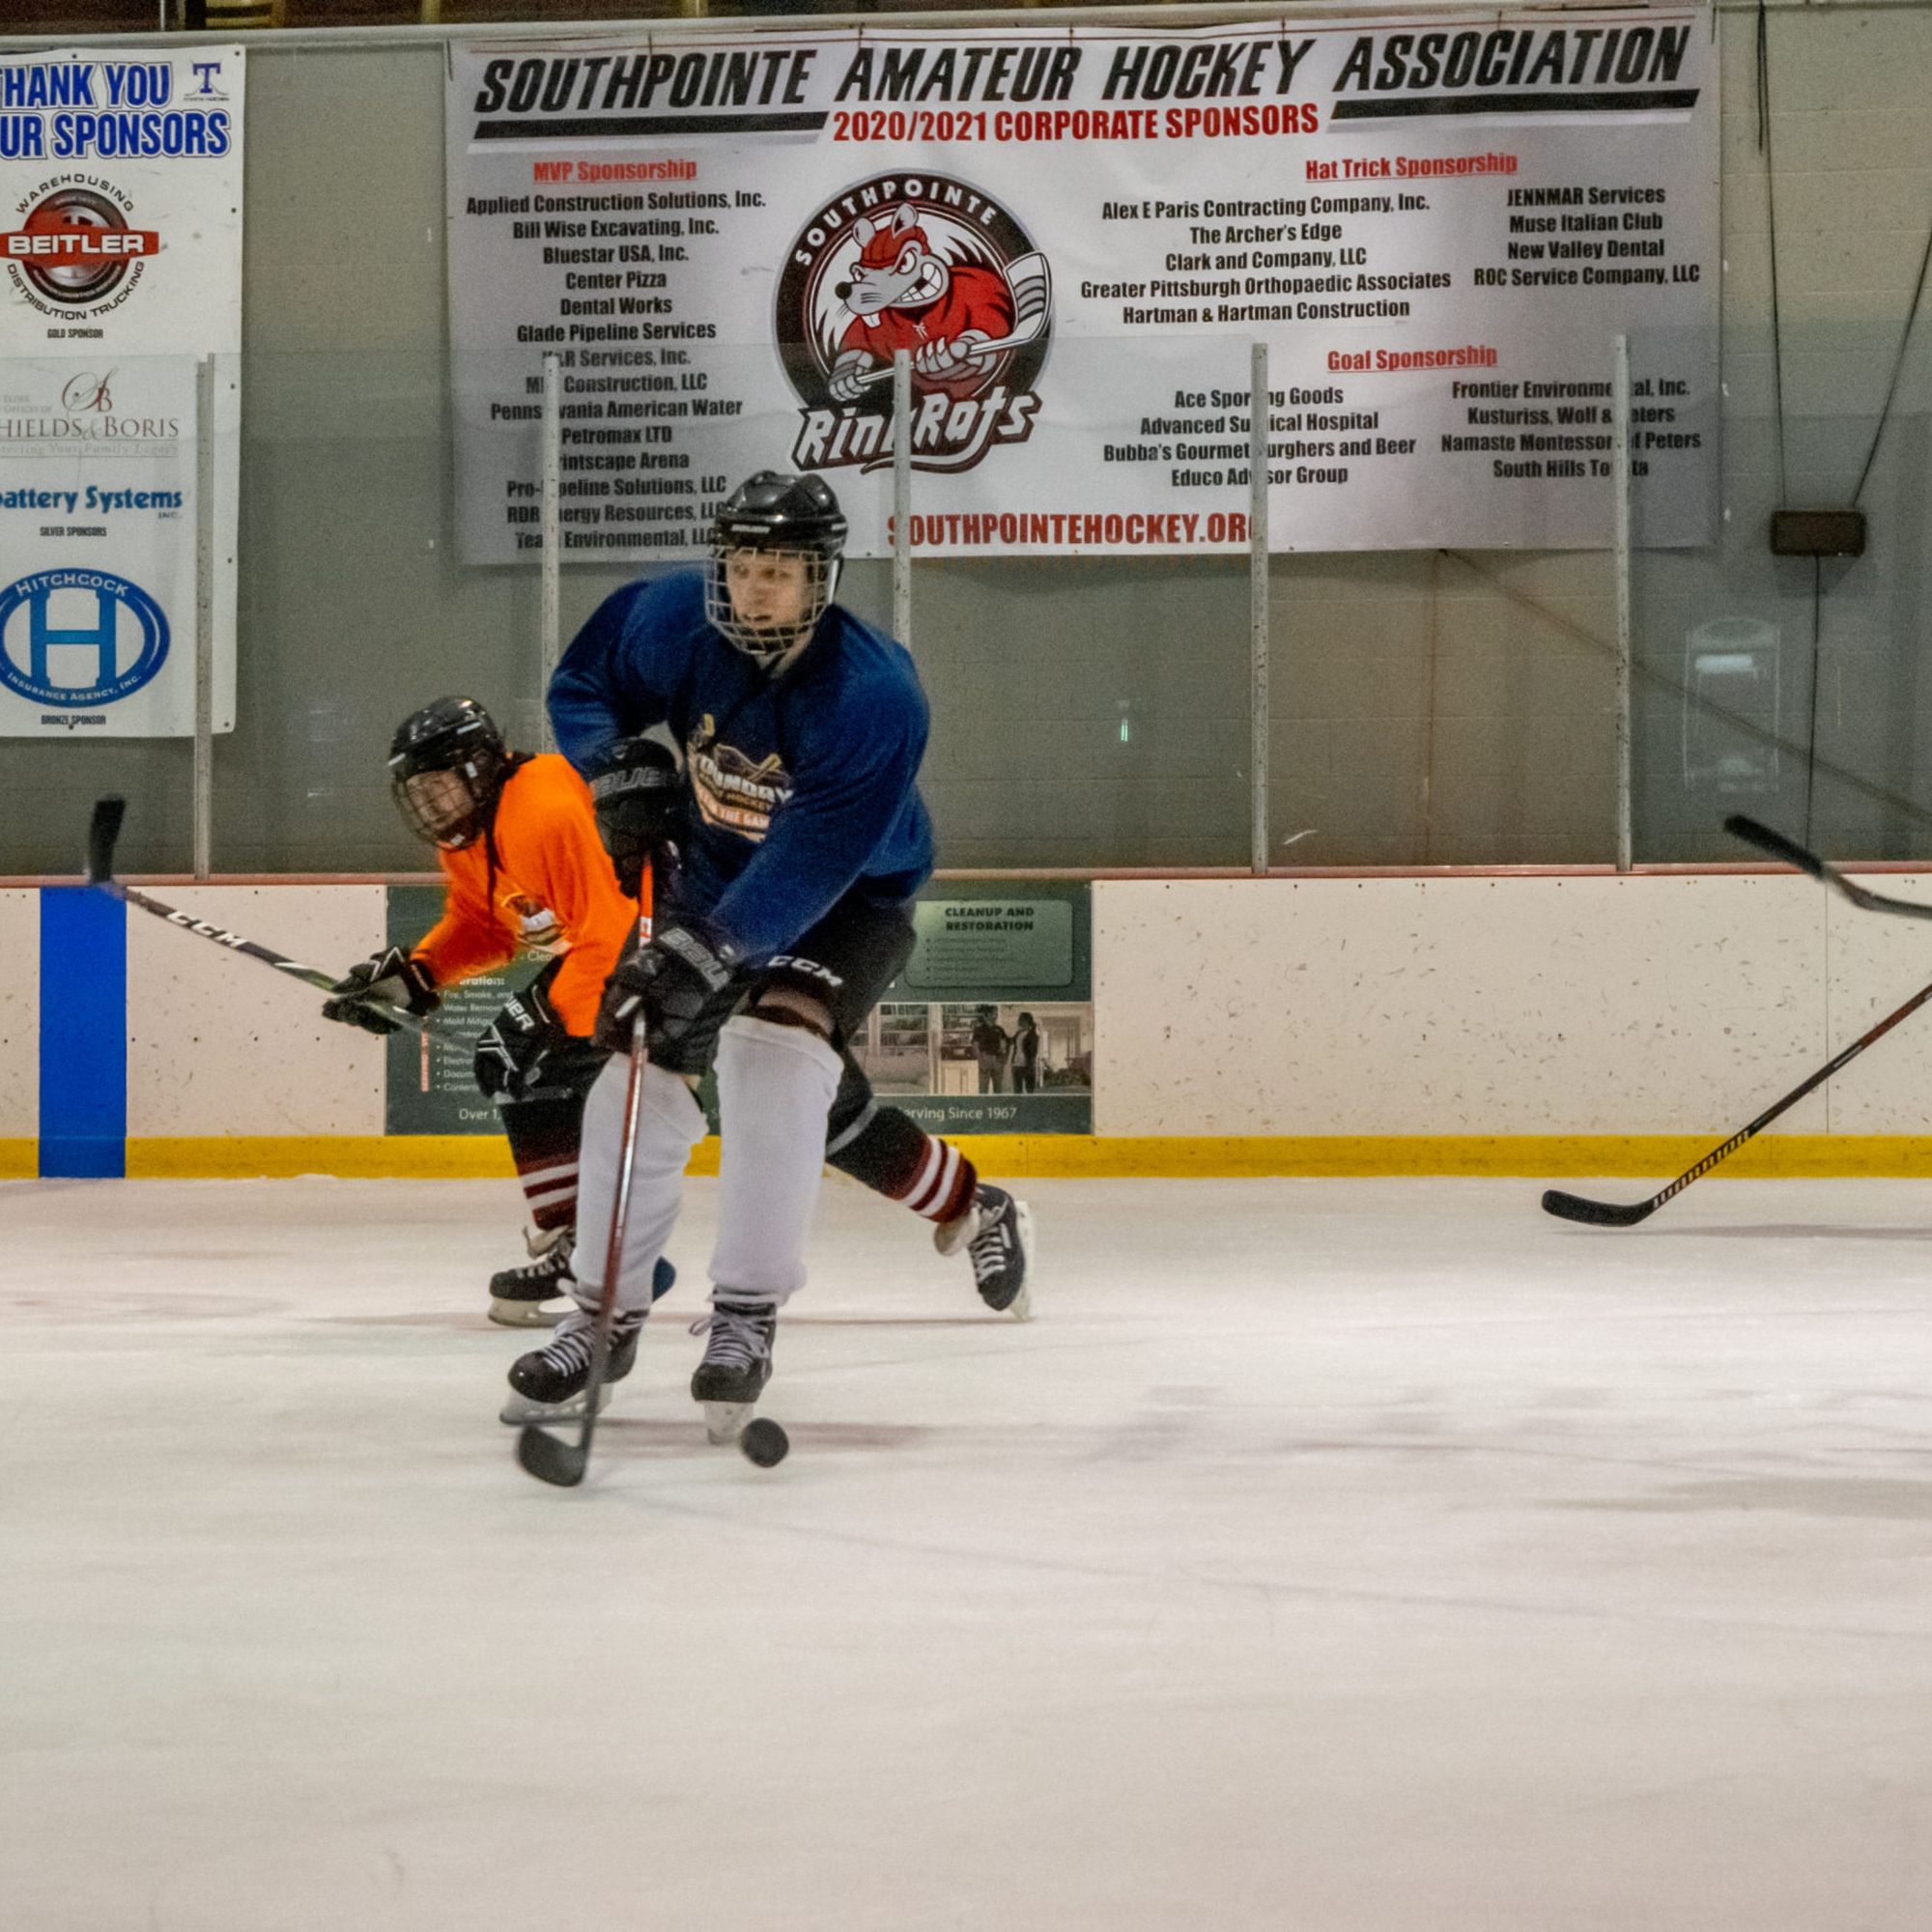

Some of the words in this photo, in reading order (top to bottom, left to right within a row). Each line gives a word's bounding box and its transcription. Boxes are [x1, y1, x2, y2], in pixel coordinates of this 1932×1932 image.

[473, 49, 818, 113] SOUTHPOINTE
[834, 46, 1083, 102] AMATEUR
[1101, 39, 1317, 100] HOCKEY
[1331, 25, 1691, 92] ASSOCIATION
[0, 63, 96, 107] HANK
[105, 62, 171, 105] YOU
[834, 110, 987, 142] 2020/2021
[994, 108, 1158, 142] CORPORATE
[1165, 103, 1319, 139] SPONSORS
[54, 112, 230, 156] SPONSORS
[534, 163, 571, 181] MVP
[579, 160, 696, 182] Sponsorship
[1306, 162, 1337, 179] Hat
[1345, 159, 1389, 177] Trick
[1397, 155, 1518, 177] Sponsorship
[14, 174, 134, 214] WAREHOUSING
[468, 196, 529, 214] Applied
[534, 194, 643, 213] Construction
[648, 192, 730, 210] Solutions,
[736, 191, 765, 207] Inc.
[1508, 187, 1583, 206] JENNMAR
[1589, 187, 1664, 204] Services
[1103, 203, 1138, 219] Alex
[1143, 202, 1151, 218] E
[1155, 202, 1199, 217] Paris
[1205, 199, 1305, 217] Contracting
[1311, 197, 1393, 213] Company,
[1399, 194, 1429, 210] Inc.
[514, 222, 540, 239] Bill
[545, 221, 586, 238] Wise
[591, 219, 684, 237] Excavating,
[689, 218, 719, 234] Inc.
[794, 179, 998, 267] SOUTHPOINTE
[1510, 216, 1556, 232] Muse
[1562, 214, 1618, 231] Italian
[1623, 213, 1662, 230] Club
[1190, 227, 1220, 243] The
[1226, 226, 1296, 242] Archer's
[1302, 223, 1341, 242] Edge
[8, 235, 144, 254] BEITLER
[544, 247, 614, 264] Bluestar
[619, 245, 654, 262] USA,
[659, 244, 688, 261] Inc.
[1508, 242, 1544, 259] New
[1548, 242, 1603, 259] Valley
[1607, 240, 1663, 257] Dental
[1166, 254, 1210, 270] Clark
[1216, 253, 1247, 270] and
[1253, 252, 1335, 268] Company,
[1341, 248, 1366, 265] LLC
[566, 272, 622, 289] Center
[627, 271, 667, 288] Pizza
[1082, 282, 1146, 298] Greater
[1151, 279, 1239, 298] Pittsburgh
[1245, 275, 1351, 295] Orthopaedic
[1357, 273, 1451, 290] Associates
[1475, 269, 1507, 286] ROC
[1512, 269, 1577, 286] Service
[1583, 268, 1667, 285] Company,
[1673, 265, 1699, 282] LLC
[7, 263, 87, 320] DISTRIBUTION
[91, 261, 145, 318] TRUCKING
[561, 298, 614, 315] Dental
[619, 298, 671, 314] Works
[1123, 307, 1197, 323] Hartman
[1203, 308, 1213, 322] &
[1218, 305, 1292, 321] Hartman
[1297, 300, 1409, 319] Construction
[47, 329, 66, 338] GOLD
[69, 328, 102, 338] SPONSOR
[518, 326, 564, 342] Glade
[570, 324, 638, 342] Pipeline
[643, 323, 716, 339] Services
[581, 350, 656, 366] Services,
[661, 349, 690, 364] Inc.
[1329, 352, 1371, 371] Goal
[1376, 346, 1495, 371] Sponsorship
[564, 376, 677, 393] Construction,
[682, 374, 707, 390] LLC
[1453, 382, 1519, 398] Frontier
[1523, 379, 1654, 399] Environmeal,
[1659, 379, 1689, 395] Inc.
[1176, 391, 1206, 408] Ace
[1210, 388, 1285, 409] Sporng
[1290, 387, 1343, 405] Goods
[491, 401, 604, 420] Pennsvania
[607, 401, 687, 417] American
[692, 399, 742, 415] Water
[1468, 408, 1552, 425] Kusturiss,
[1557, 407, 1597, 424] Wolf
[1602, 410, 1612, 423] &
[1631, 406, 1675, 423] eters
[103, 415, 180, 438] BORIS
[1141, 417, 1225, 435] Advanced
[1230, 413, 1302, 433] Suical
[1307, 412, 1378, 431] Hospital
[562, 428, 640, 444] Petromax
[646, 426, 671, 442] LTD
[1442, 436, 1515, 451] Namaste
[1520, 433, 1612, 451] Montessor
[1645, 432, 1700, 448] Peters
[1104, 444, 1171, 461] Bubba's
[1177, 443, 1249, 460] Gourmet
[1267, 439, 1335, 459] urghers
[1340, 439, 1371, 456] and
[1377, 439, 1415, 454] Beer
[558, 453, 636, 471] intscape
[640, 453, 689, 469] Arena
[1494, 460, 1542, 477] South
[1547, 460, 1585, 476] Hills
[1590, 459, 1648, 476] Tota
[507, 479, 610, 497] Pro-peline
[614, 478, 696, 496] Solutions,
[701, 476, 725, 493] LLC
[1172, 469, 1222, 486] Educo
[1227, 468, 1292, 486] Adsor
[1297, 467, 1348, 484] Group
[0, 488, 78, 514] attery
[85, 485, 183, 514] Systems
[558, 506, 600, 525] ergy
[605, 505, 696, 521] Resources,
[41, 526, 64, 536] SILVER
[67, 527, 106, 536] SPONSORS
[516, 531, 559, 549] Tea
[565, 529, 687, 548] Environmental,
[887, 513, 1253, 547] OUTHPOINTEHOCKEY.OR
[15, 573, 128, 597] HITCHCOCK
[42, 715, 71, 726] BRONZE
[69, 716, 105, 726] SPONSOR
[946, 908, 1002, 917] CLEANUP
[166, 910, 248, 949] CCM
[947, 922, 1033, 930] RESTORATION
[459, 1109, 489, 1121] Over
[949, 1107, 983, 1119] Since
[988, 1108, 1017, 1119] 1967
